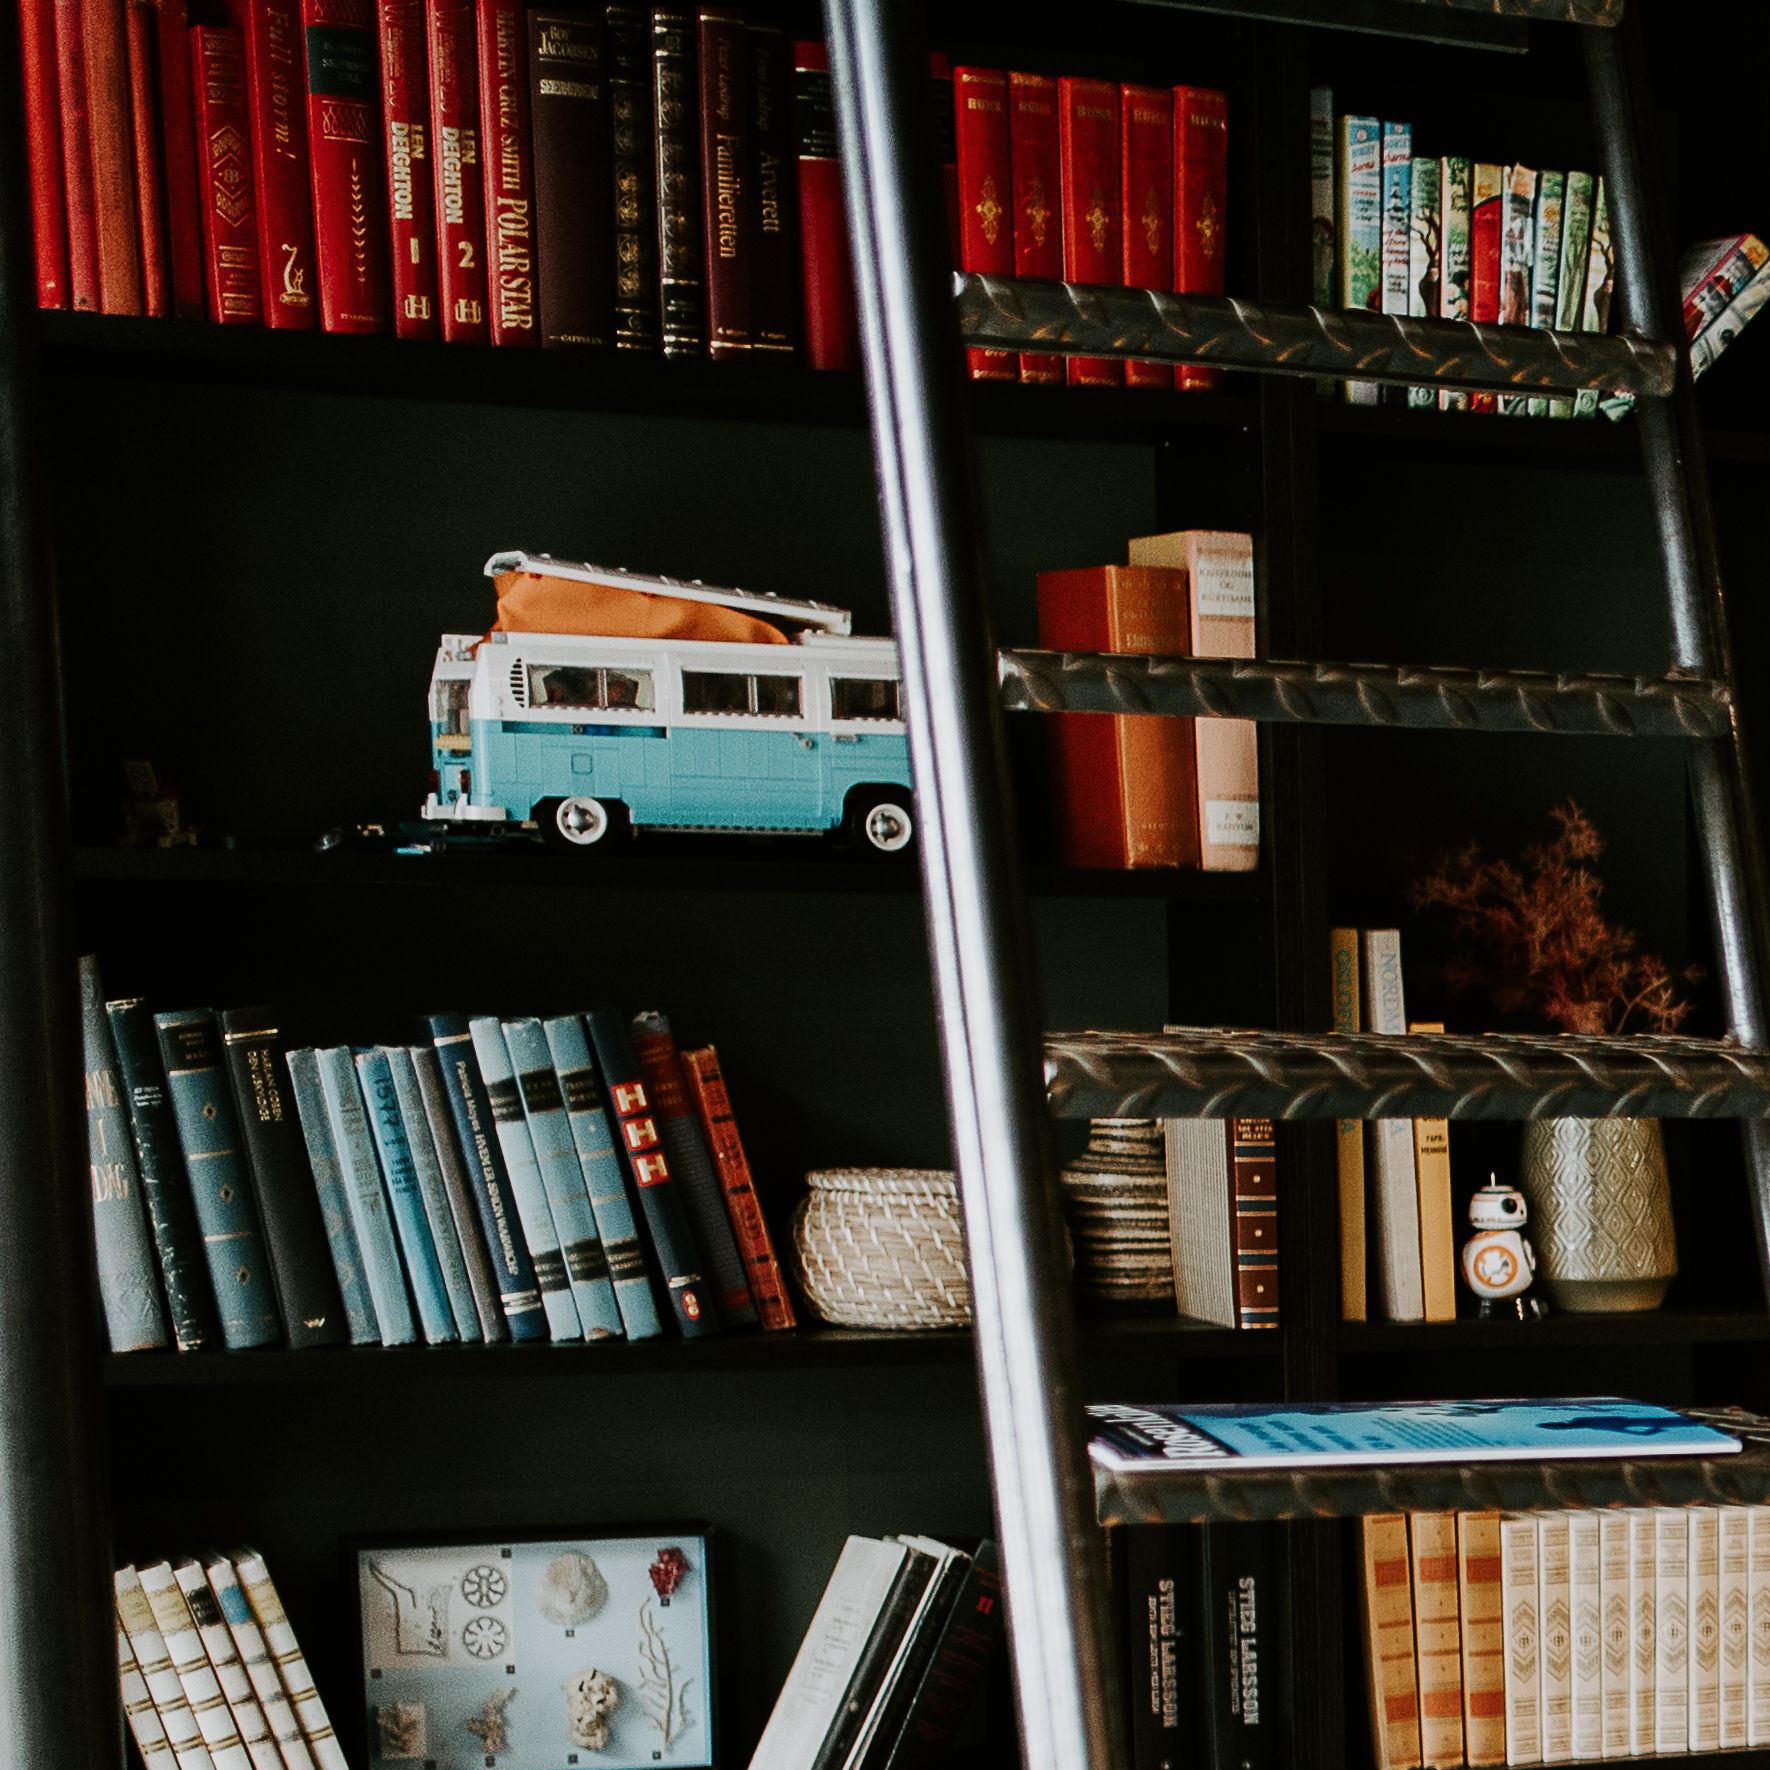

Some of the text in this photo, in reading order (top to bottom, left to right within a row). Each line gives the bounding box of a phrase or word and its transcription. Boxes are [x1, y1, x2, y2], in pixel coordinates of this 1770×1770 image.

[538, 31, 598, 59] JACOBSEN
[390, 120, 414, 220] DEIGHTON
[408, 123, 426, 160] LEN
[459, 128, 477, 165] LEN
[496, 8, 533, 331] MARTIN CRUZ SMITH POLAR STAR
[441, 125, 464, 224] DEIGHTON
[716, 131, 742, 259] Familieretten
[760, 150, 783, 234] Arverett
[457, 241, 476, 269] 2
[615, 1082, 648, 1114] H
[626, 1118, 658, 1149] H
[636, 1154, 668, 1185] H
[1157, 1577, 1179, 1728] STIEG LARSSON
[1238, 1575, 1260, 1726] STIEG LARSSON
